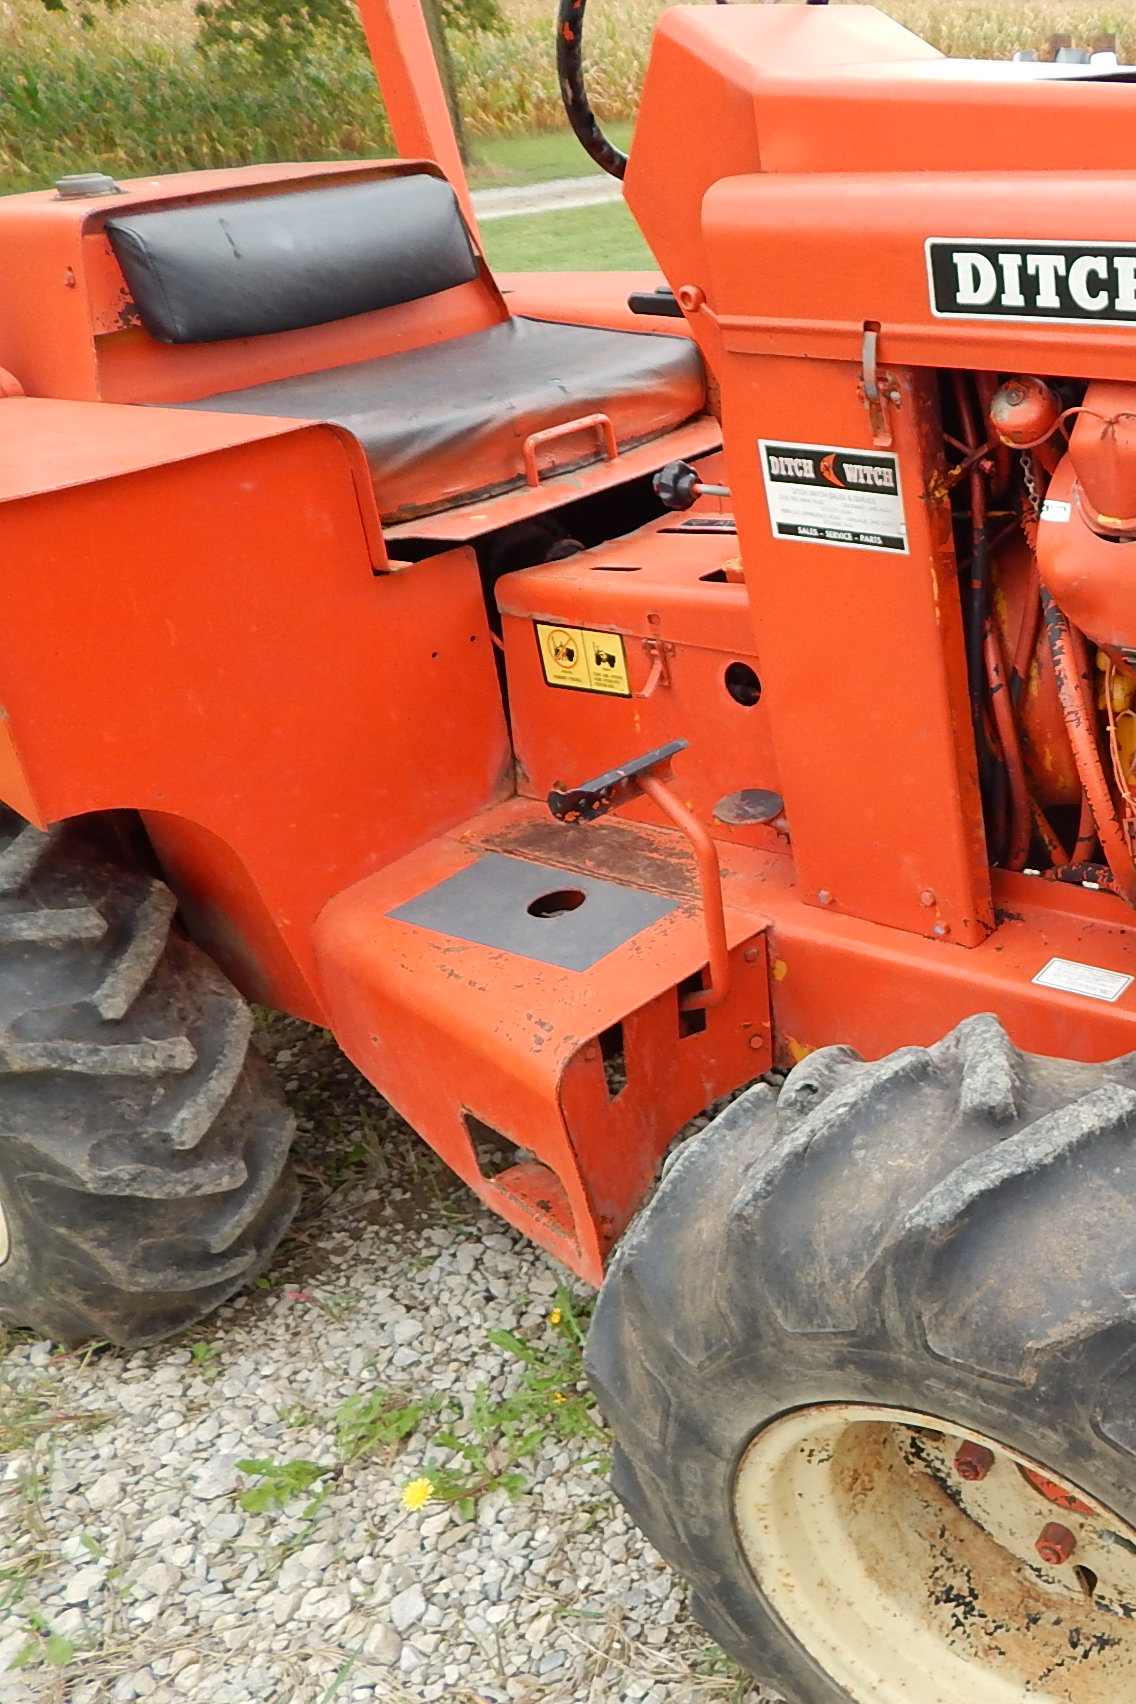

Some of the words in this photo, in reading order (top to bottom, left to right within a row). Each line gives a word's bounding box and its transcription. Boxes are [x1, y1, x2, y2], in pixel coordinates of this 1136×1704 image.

[769, 456, 816, 478] DITCH
[842, 463, 895, 487] WITCH
[797, 526, 819, 536] SALES
[825, 530, 854, 541] SERVICE
[859, 534, 883, 544] PARTS
